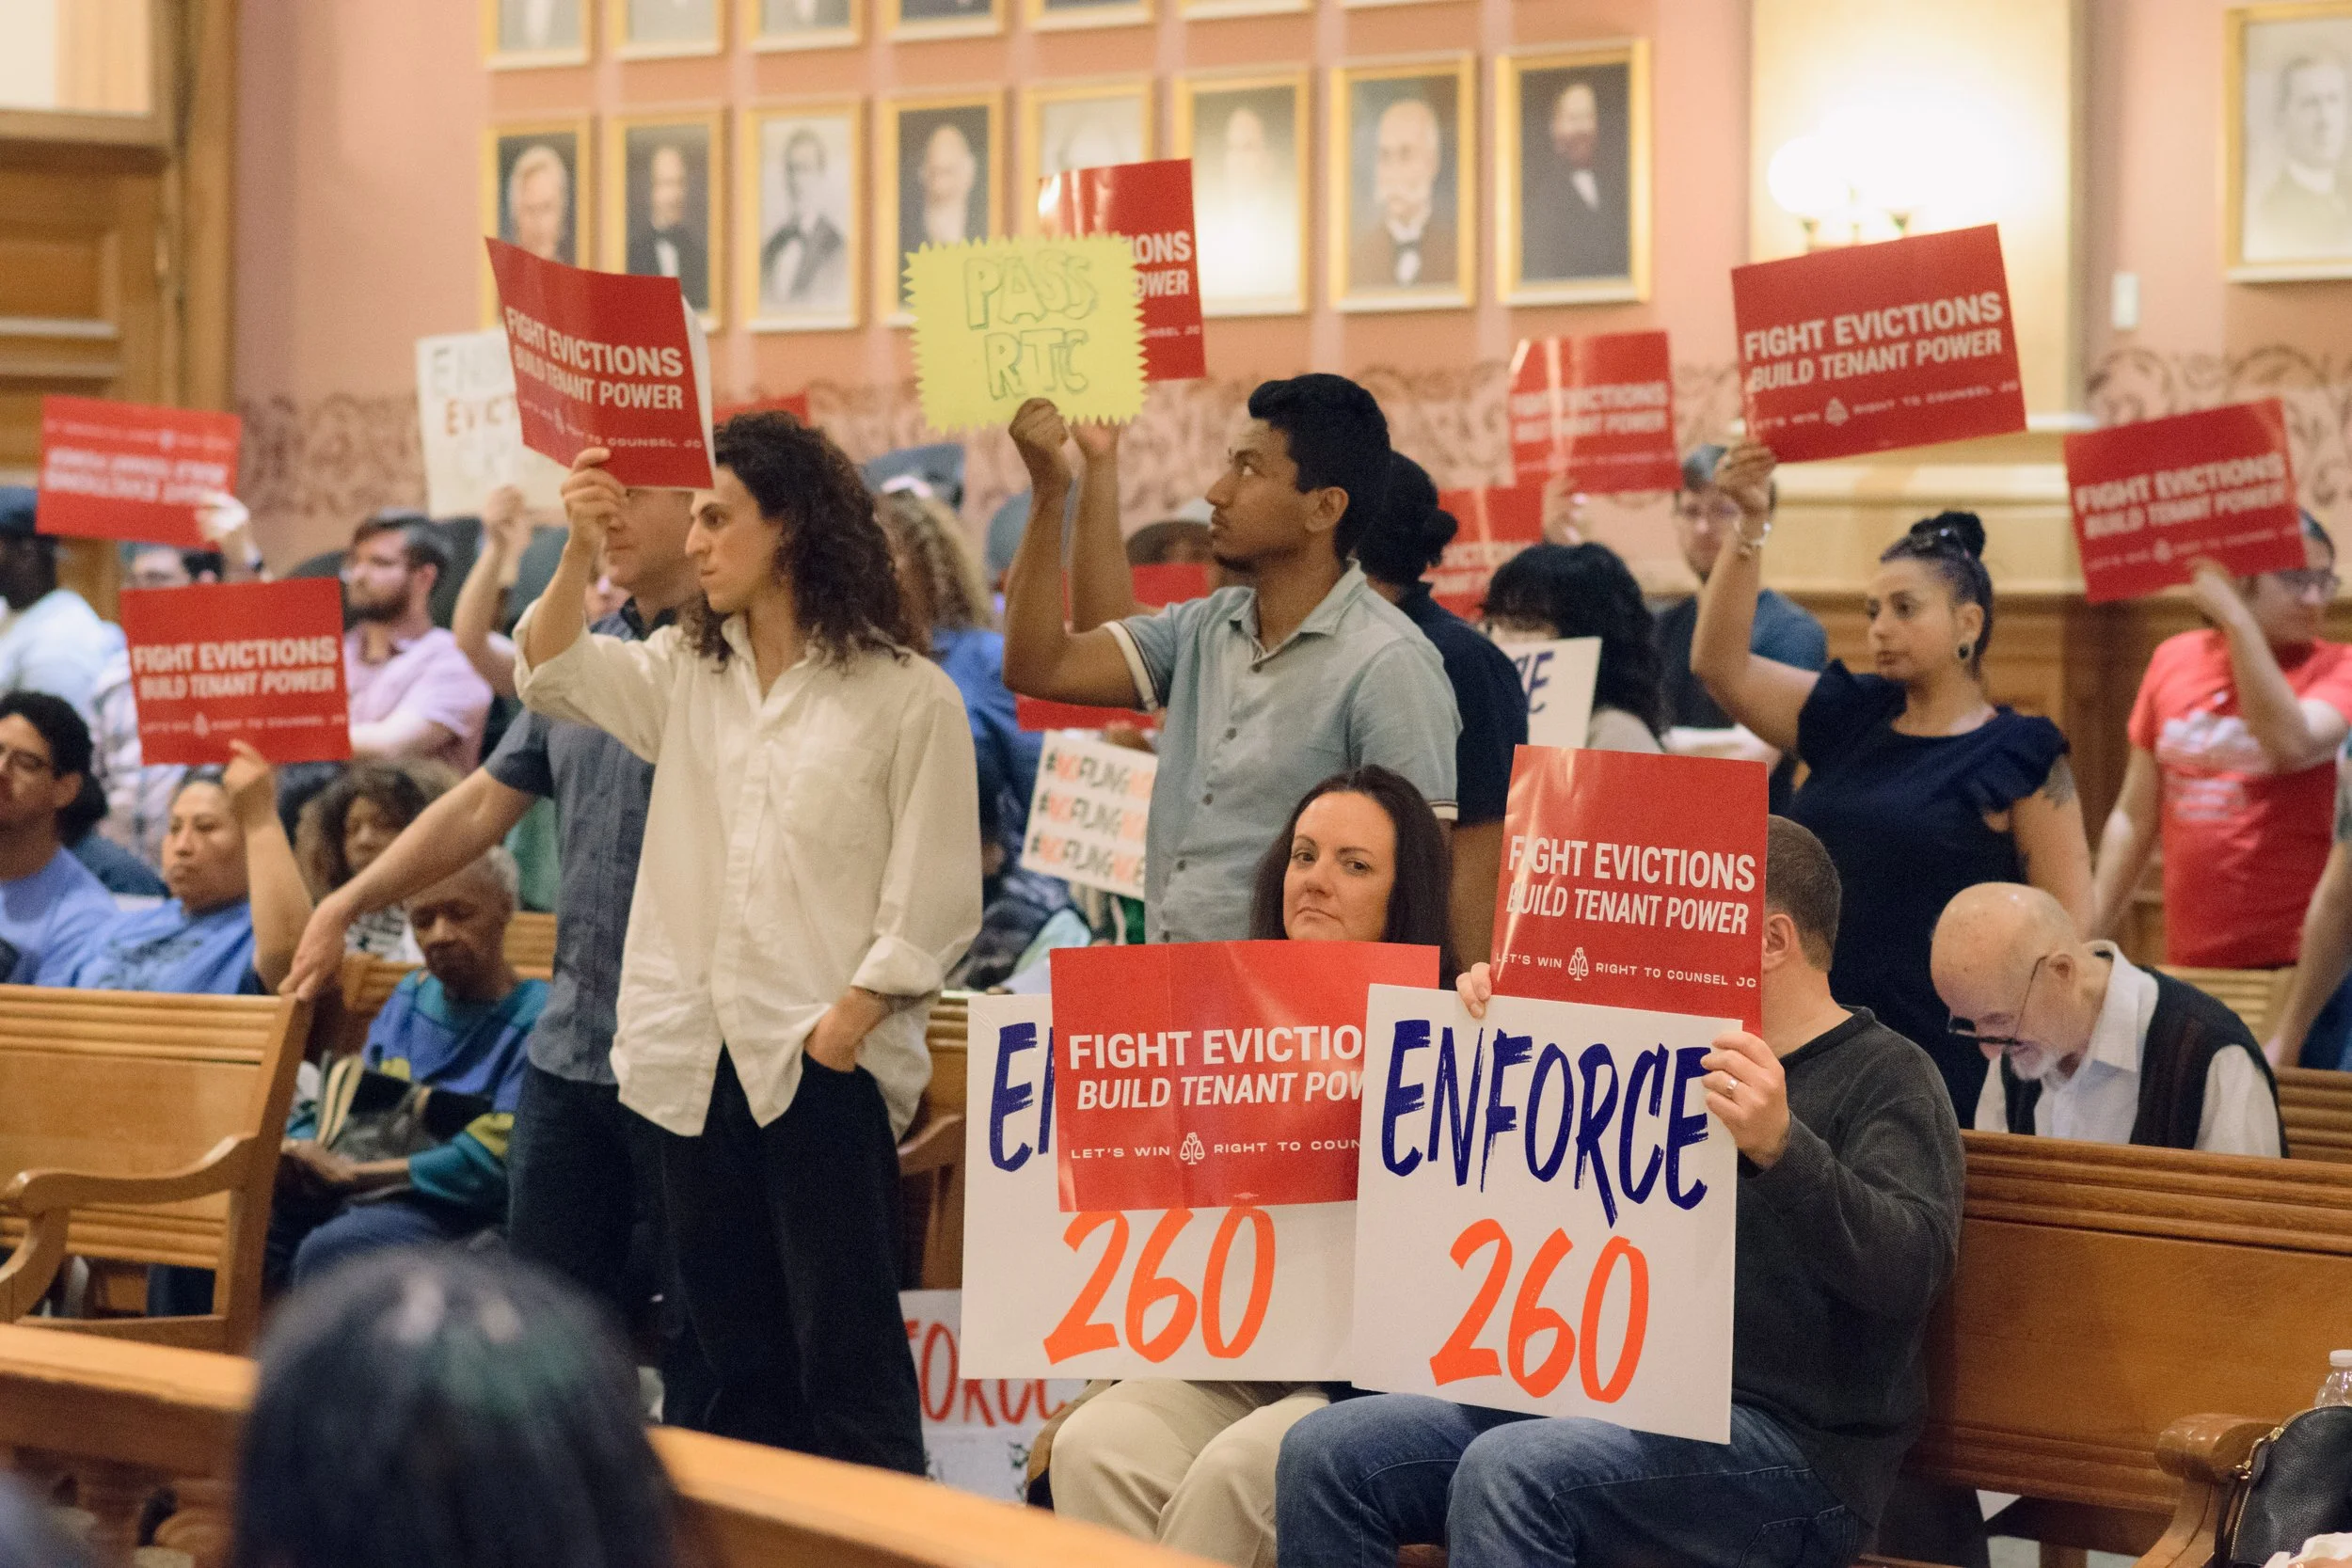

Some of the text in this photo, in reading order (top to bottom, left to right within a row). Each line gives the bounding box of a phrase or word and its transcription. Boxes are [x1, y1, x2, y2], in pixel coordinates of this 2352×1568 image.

[964, 248, 1098, 330] PASS
[505, 306, 546, 352] FIGHT
[548, 329, 684, 378] EVICTIONS
[1744, 291, 2003, 361] FIGHT EVICTIONS
[984, 327, 1089, 402] RTC
[1748, 329, 2002, 393] BUILD TENANT POWER
[599, 380, 683, 410] POWER
[132, 635, 338, 673] FIGHT EVICTIONS
[261, 667, 336, 695] POWER
[1594, 842, 1756, 892] EVICTIONS
[1506, 882, 1749, 935] BUILD TENANT POWER
[1537, 957, 1563, 968] WIN
[1597, 962, 1637, 975] RIGHT
[1645, 967, 1661, 978] TO
[1667, 970, 1728, 986] COUNSEL
[1736, 977, 1756, 988] JC
[1069, 1024, 1362, 1069] FIGHT EVICTIO
[1077, 1078, 1171, 1110] BUILD
[1181, 1072, 1298, 1106] TENANT
[1071, 1148, 1124, 1159] LET'S
[1135, 1146, 1170, 1157] WIN
[1214, 1143, 1267, 1154] RIGHT
[1278, 1141, 1301, 1151] TO
[1381, 1020, 1711, 1228] ENFORCE
[1043, 1205, 1276, 1365] 260
[1429, 1219, 1649, 1403] 260
